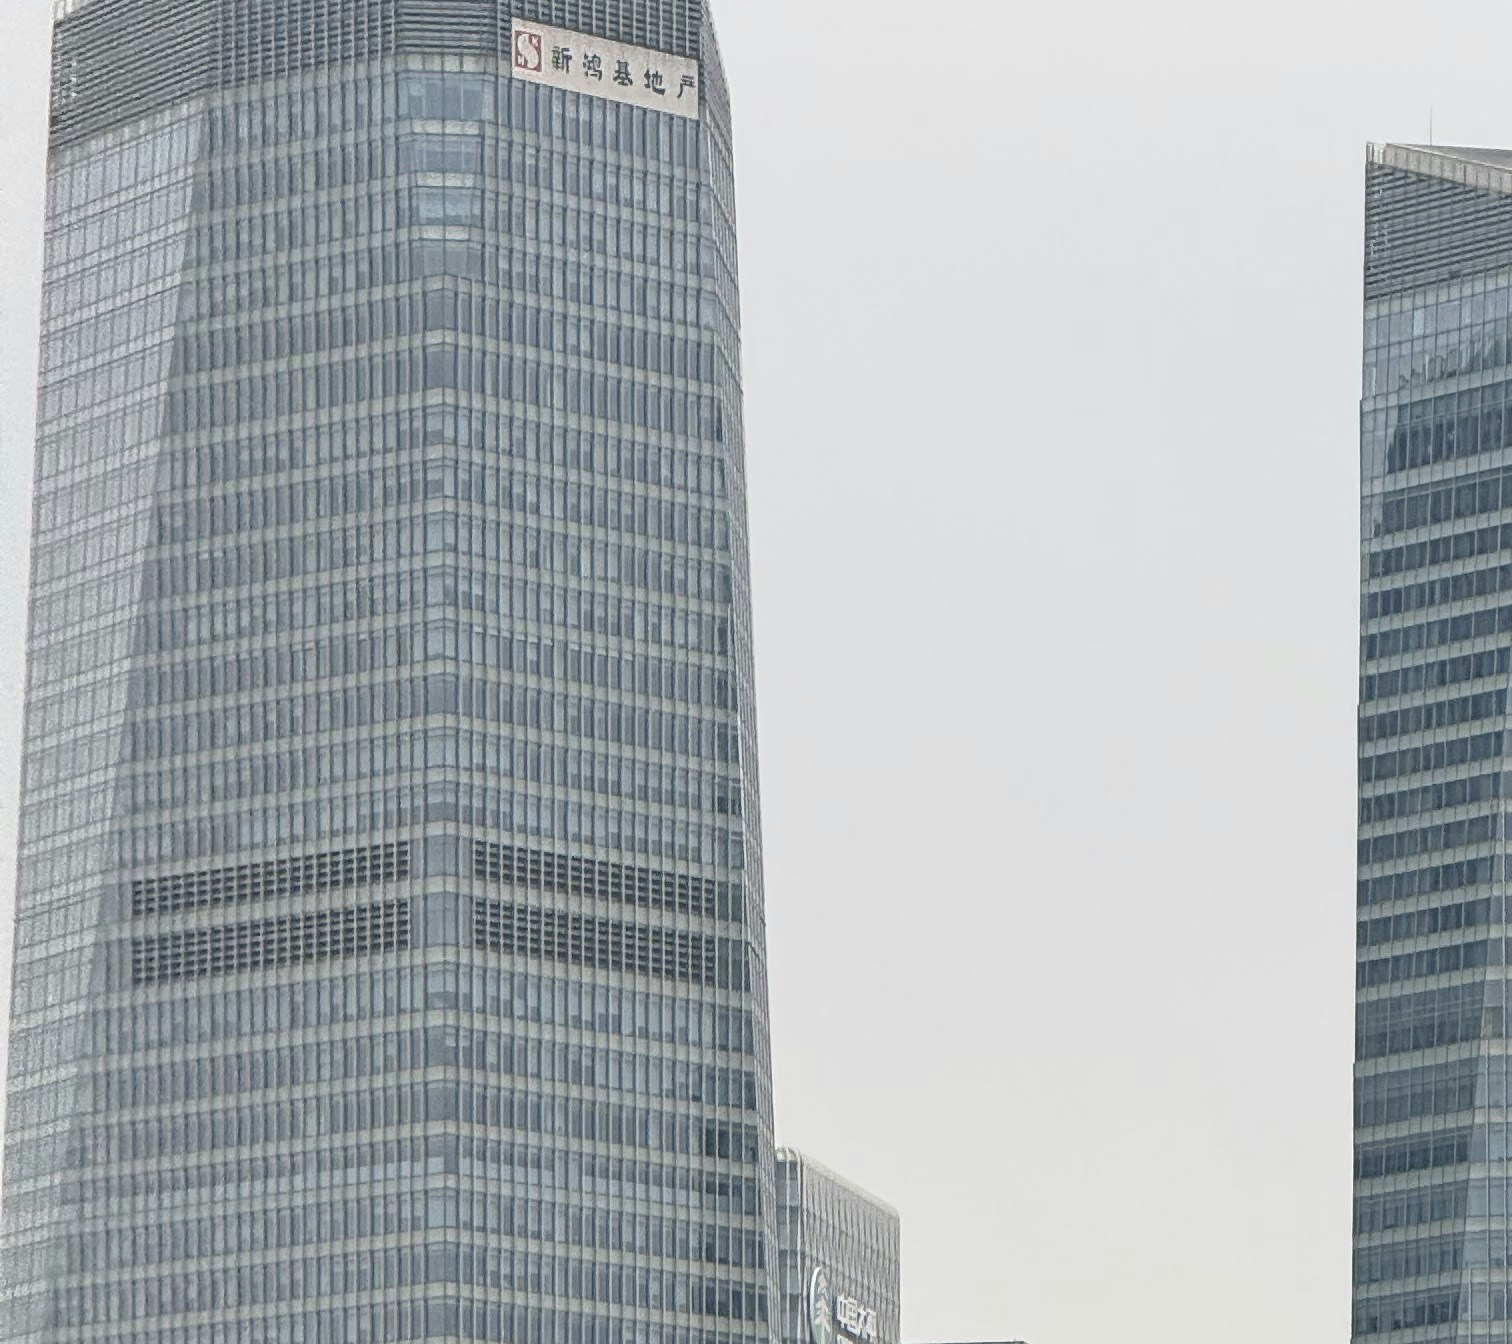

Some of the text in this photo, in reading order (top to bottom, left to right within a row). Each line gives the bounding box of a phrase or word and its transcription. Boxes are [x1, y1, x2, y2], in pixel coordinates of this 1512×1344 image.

[551, 45, 696, 98] 新鸿基地产
